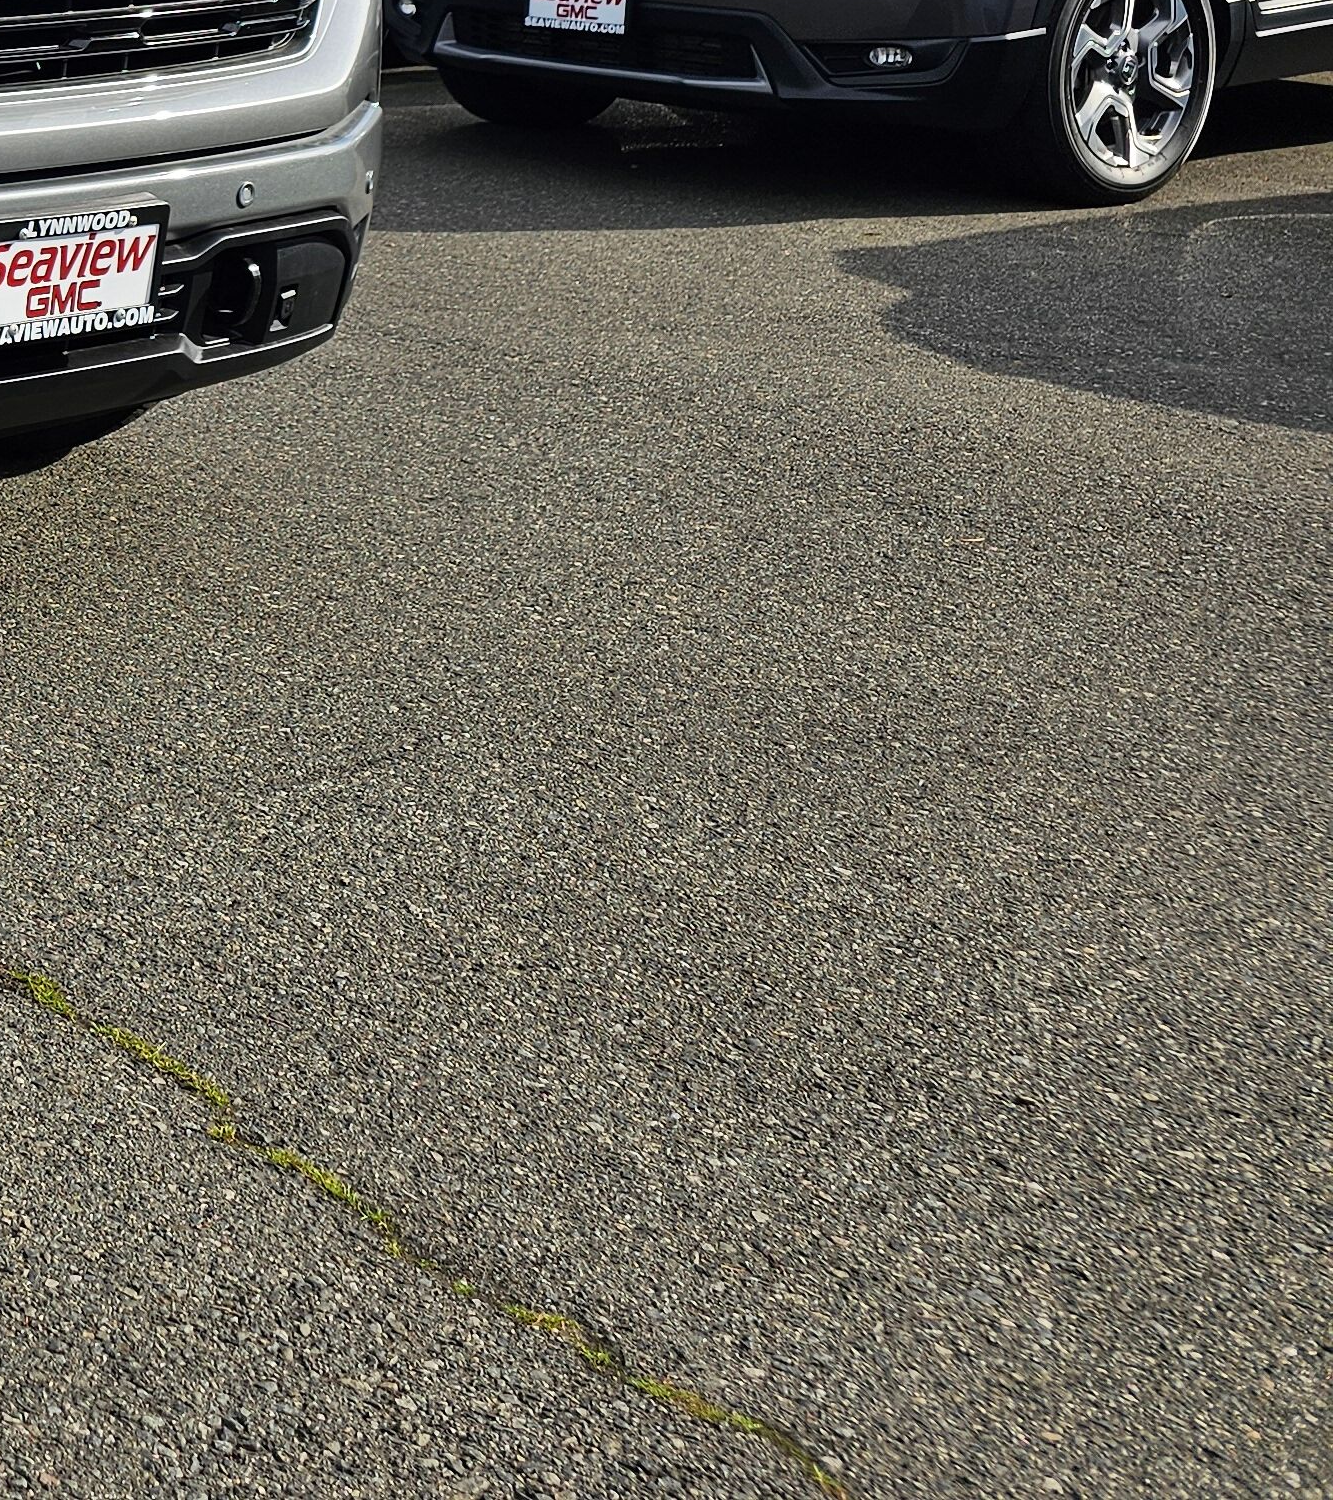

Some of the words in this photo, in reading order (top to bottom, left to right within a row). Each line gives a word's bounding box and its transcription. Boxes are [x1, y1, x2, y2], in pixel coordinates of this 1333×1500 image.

[556, 4, 599, 20] GMC
[525, 15, 625, 35] SEAVIEWAUTO.COM
[25, 210, 131, 238] LYNNWOOD
[25, 278, 102, 318] GMC
